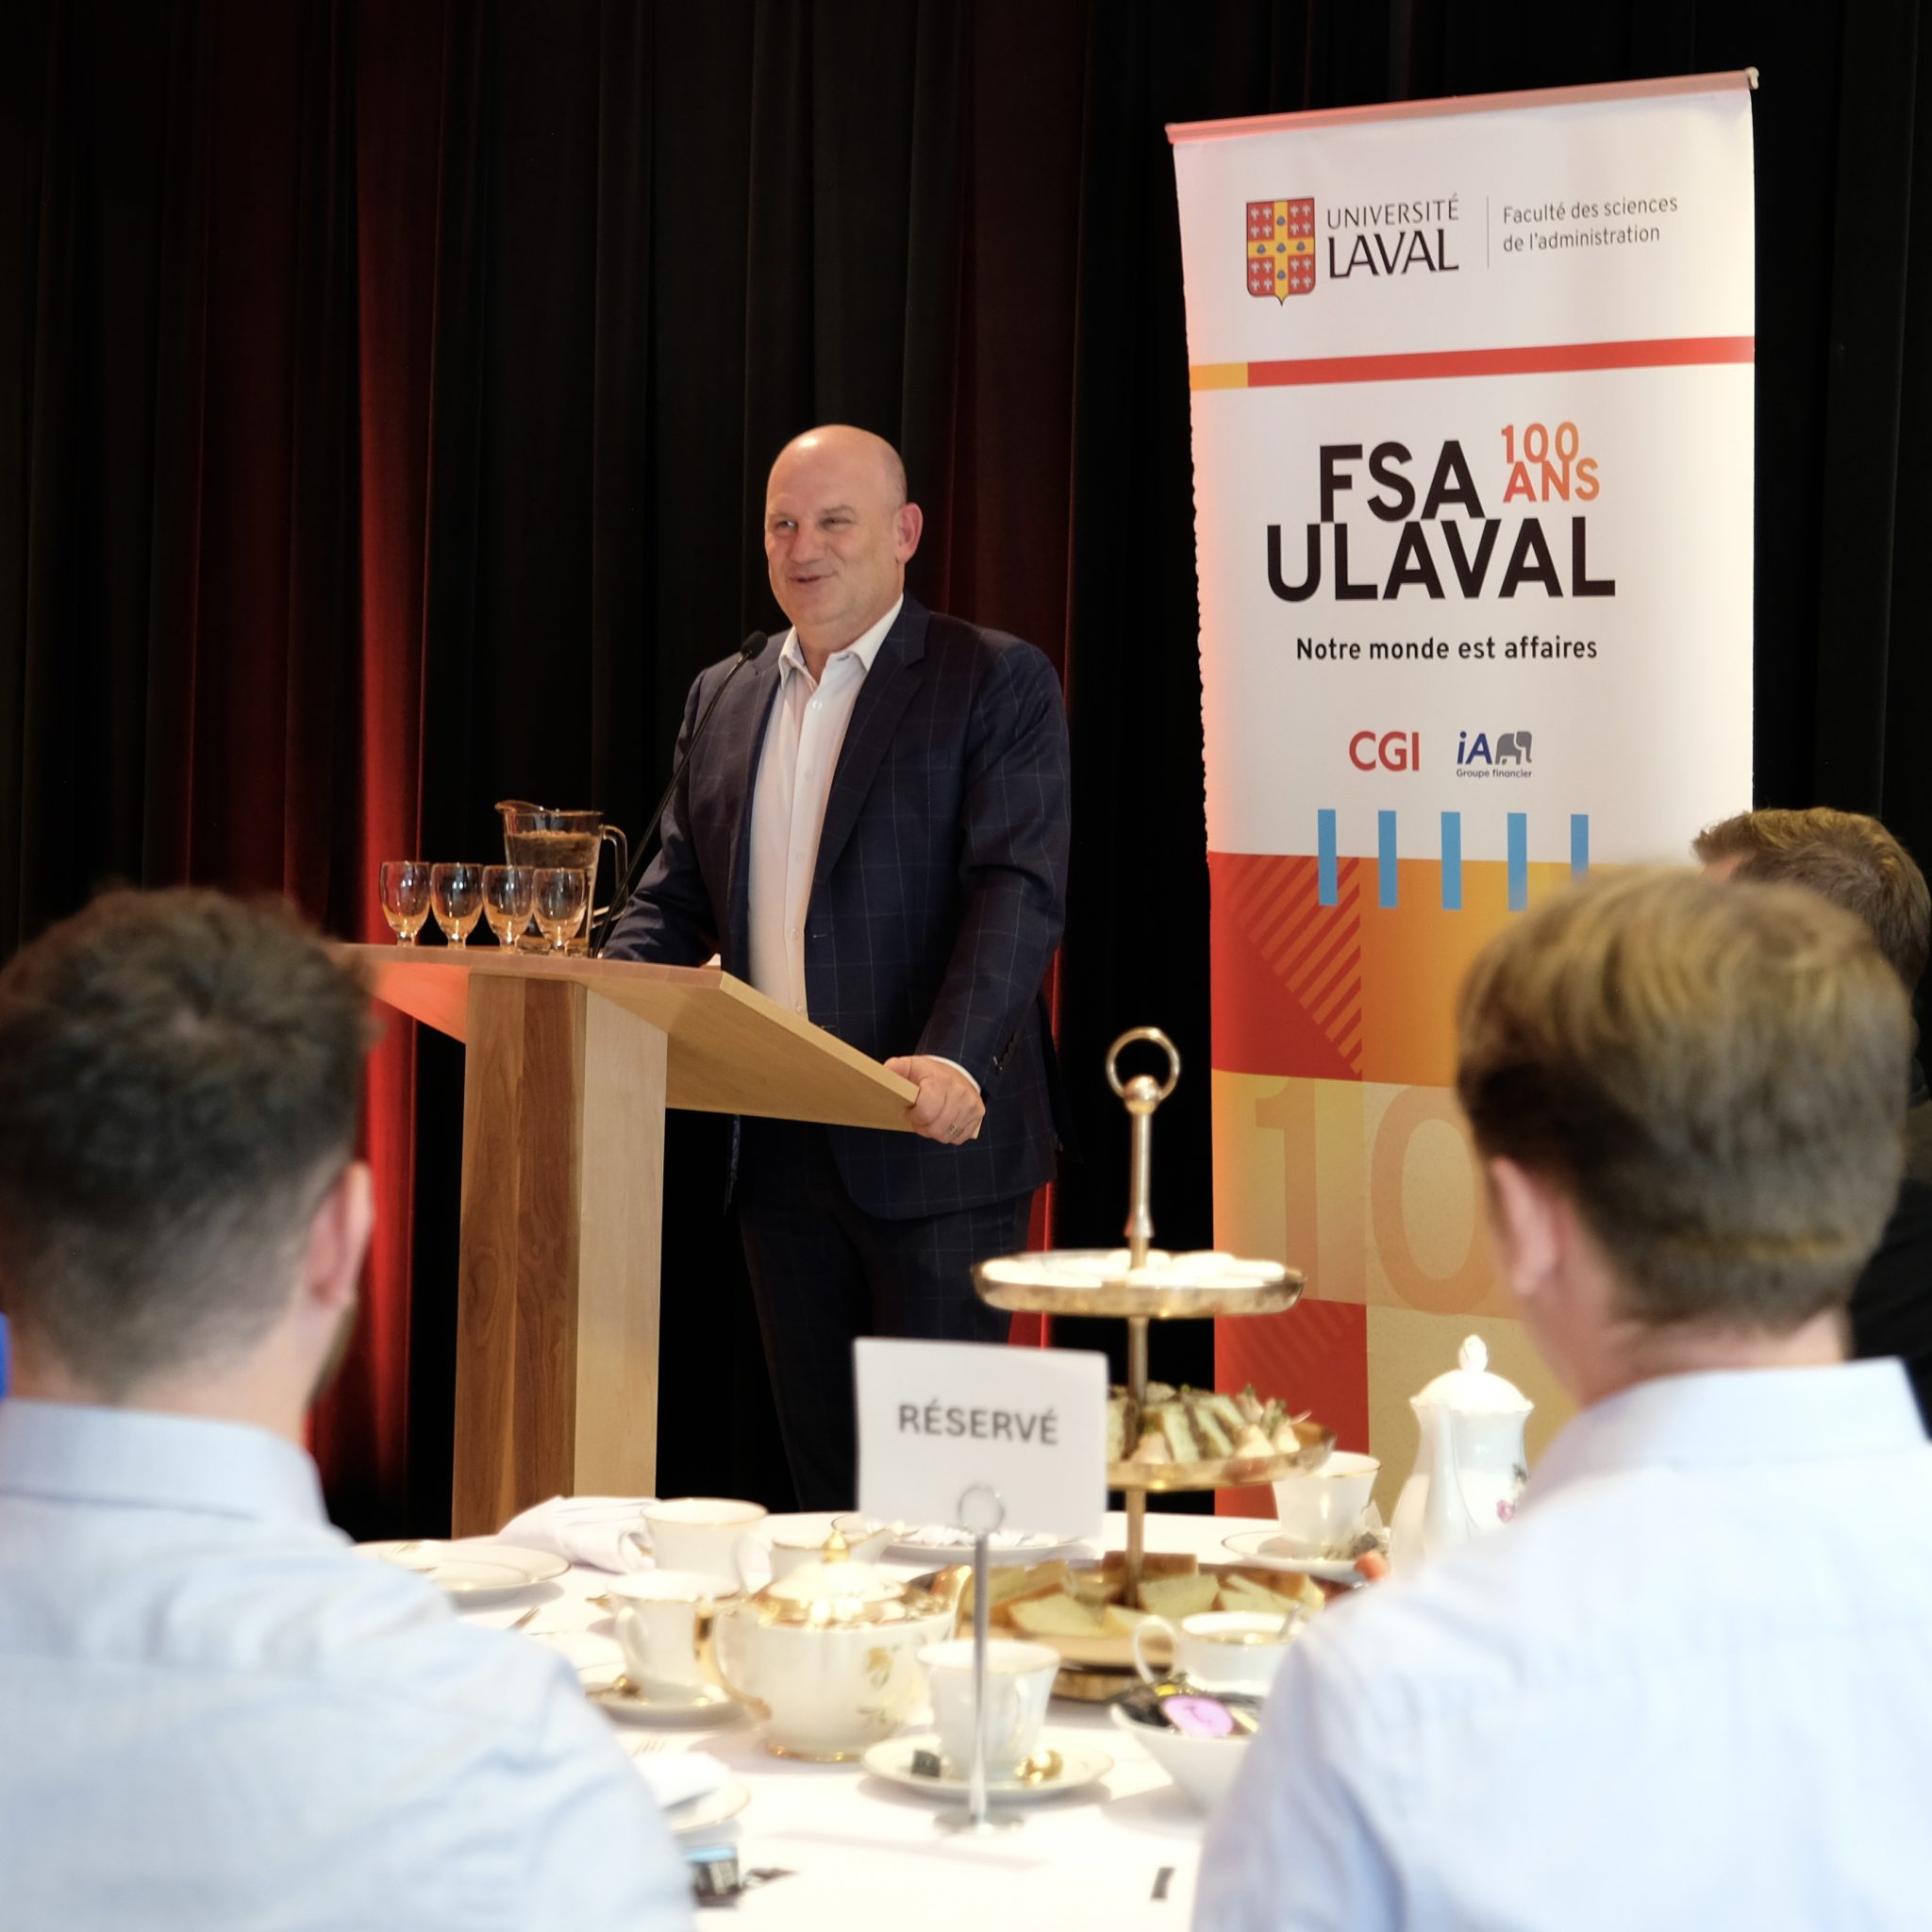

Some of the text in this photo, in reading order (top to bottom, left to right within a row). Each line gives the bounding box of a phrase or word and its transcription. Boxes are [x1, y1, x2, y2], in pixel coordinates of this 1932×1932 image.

[1326, 192, 1459, 230] UNIVERSITÉ
[1503, 196, 1678, 225] Faculté des sciences
[1327, 227, 1459, 280] LAVAL
[1503, 224, 1660, 253] de l'administration
[1501, 421, 1580, 464] 100
[1319, 440, 1487, 524] FSA
[1502, 457, 1601, 504] ANS
[1266, 516, 1616, 603] ULAVAL
[1296, 634, 1598, 661] Notre monde est affaires
[1348, 730, 1420, 772] CGI
[1456, 768, 1532, 778] Groupe financier
[898, 1398, 1058, 1446] RÉSERVÉ
